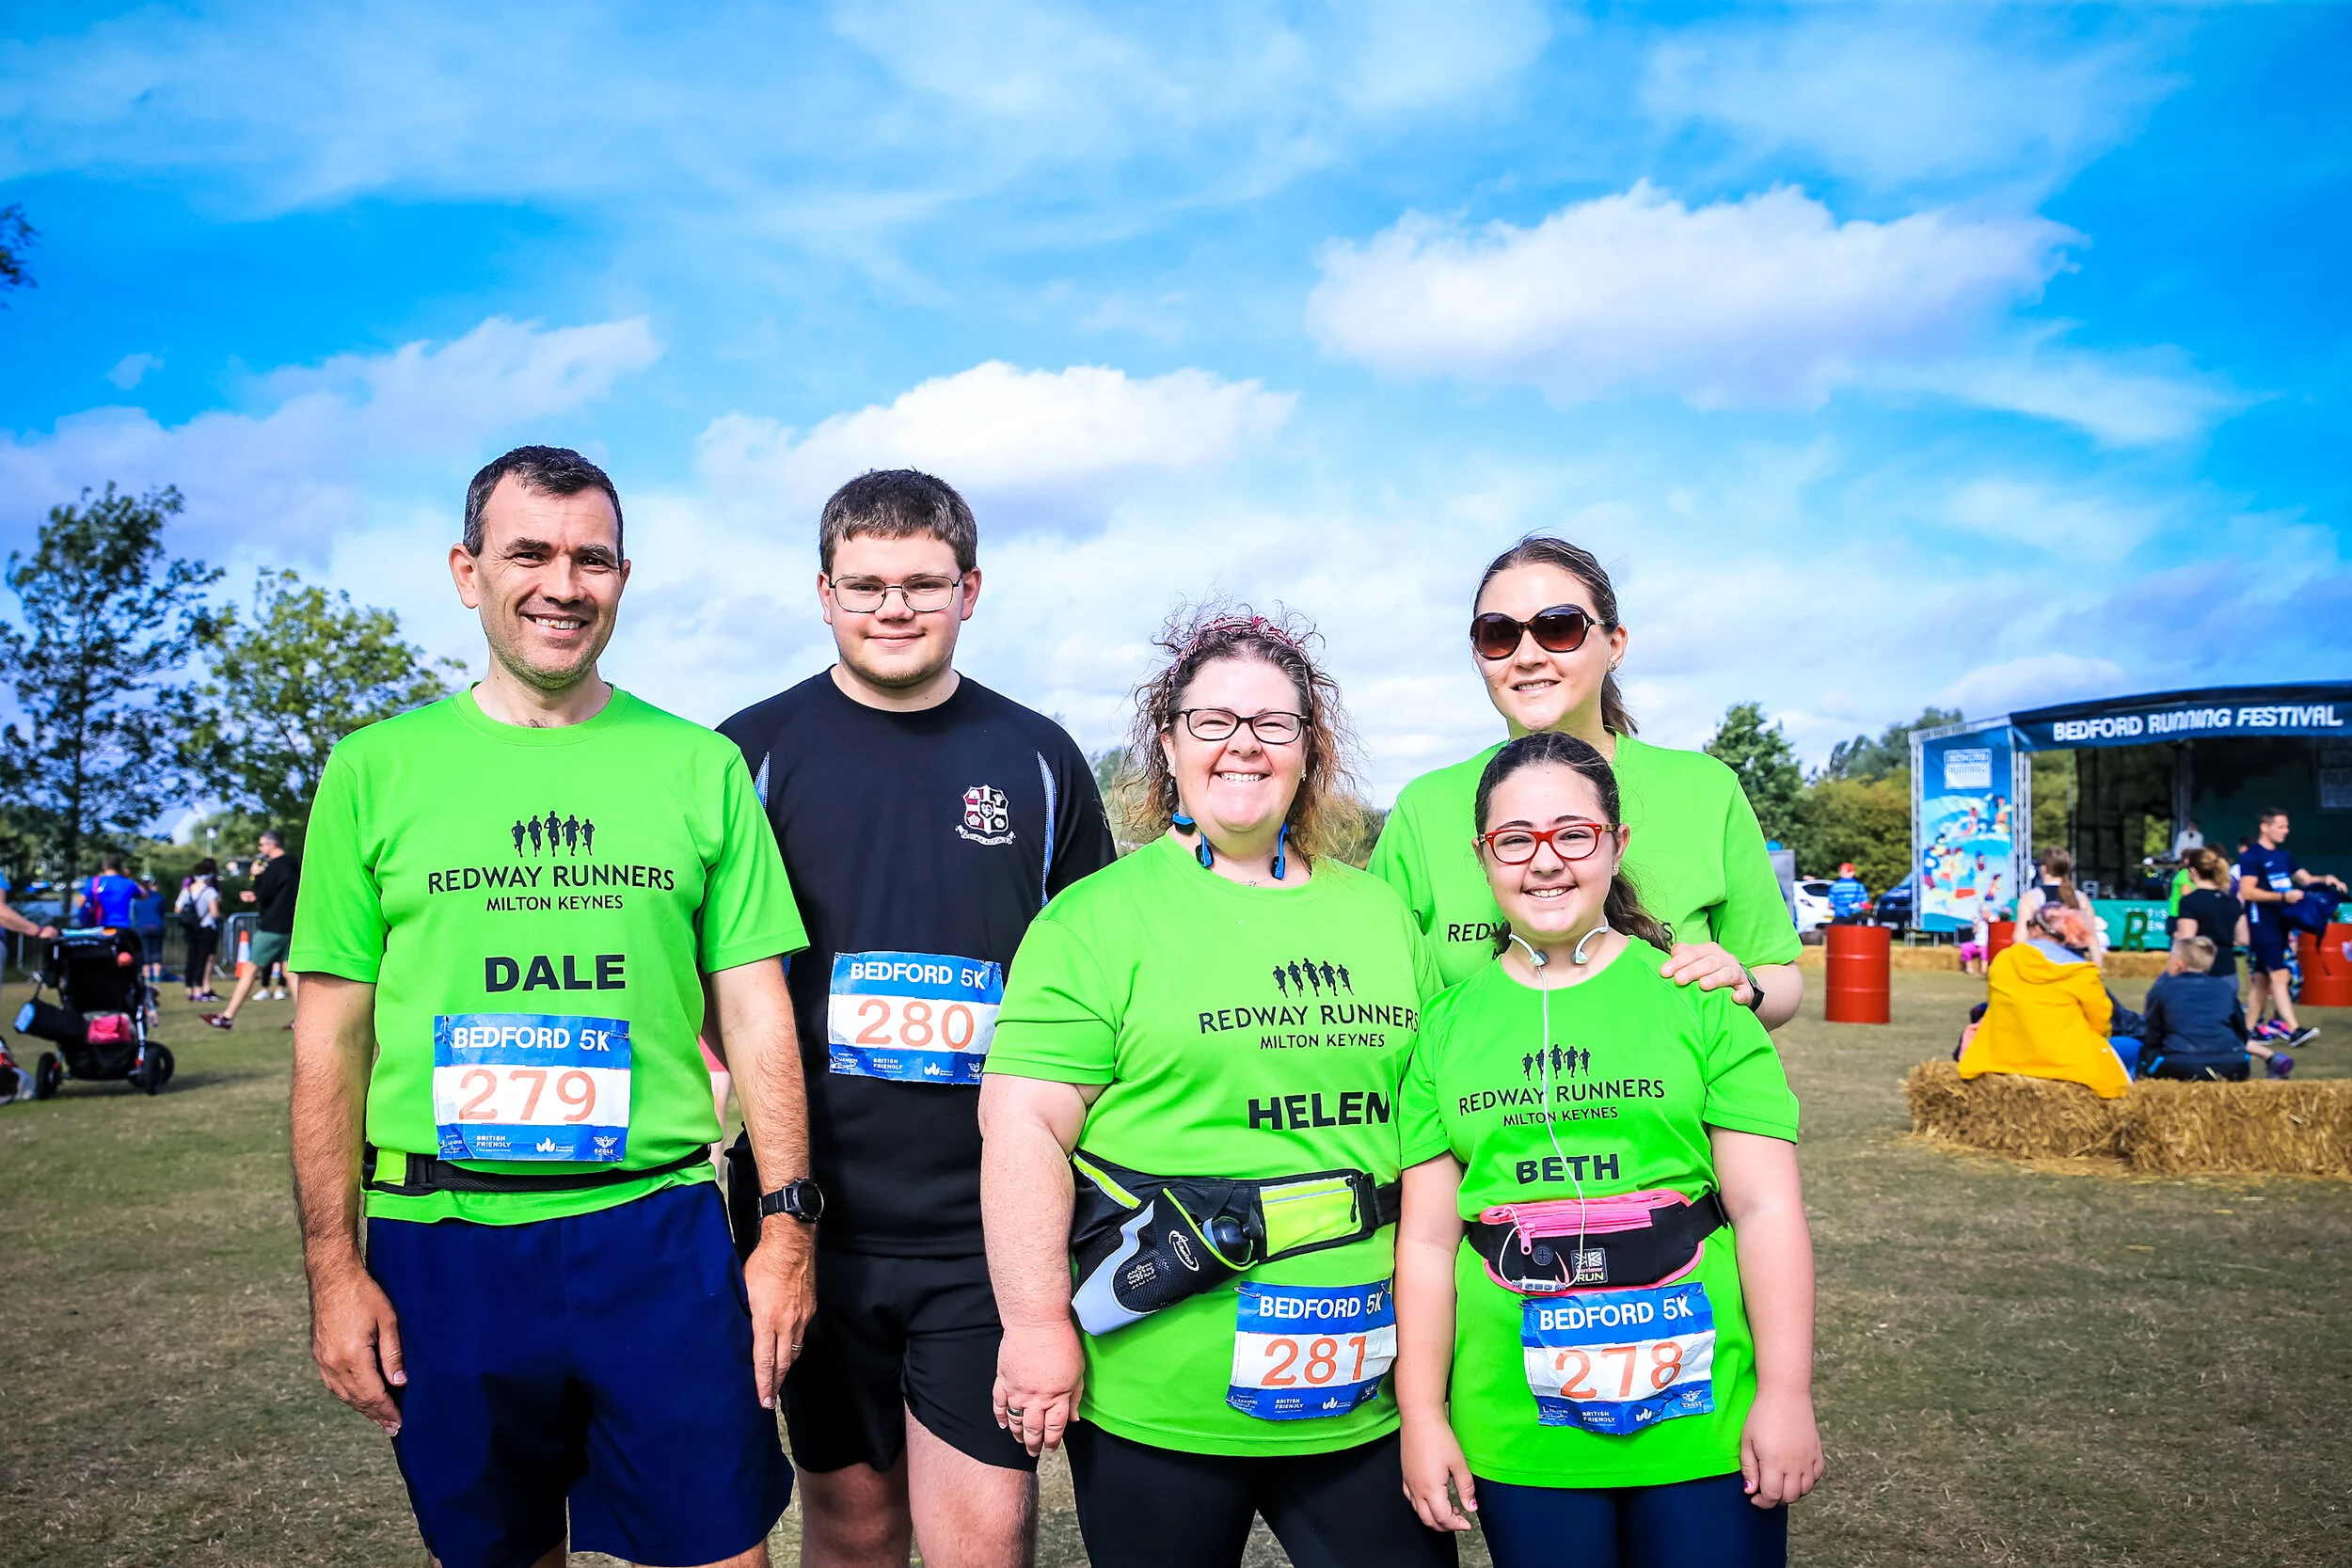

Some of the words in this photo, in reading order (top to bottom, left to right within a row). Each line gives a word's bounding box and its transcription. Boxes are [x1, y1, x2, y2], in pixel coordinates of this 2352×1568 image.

[2053, 716, 2144, 742] BEDFORD
[2236, 705, 2344, 728] FESTIVAL
[428, 865, 543, 895] REDWAY
[552, 864, 675, 892] RUNNERS
[485, 896, 551, 911] MILTON
[557, 895, 624, 911] KEYNES
[485, 954, 627, 992] DALE
[850, 961, 953, 986] BEDFORD
[960, 970, 986, 990] 5K
[855, 998, 975, 1051] 280
[1199, 1005, 1309, 1035] REDWAY
[1320, 1003, 1419, 1033] RUNNERS
[453, 1026, 571, 1051] BEDFORD
[579, 1030, 611, 1053] 5K
[1260, 1034, 1319, 1050] MILTON
[1326, 1033, 1385, 1048] KEYNES
[458, 1068, 597, 1122] 279
[1248, 1091, 1391, 1131] HELEN
[1458, 1086, 1545, 1116] REDWAY
[1556, 1079, 1665, 1103] RUNNERS
[1503, 1111, 1557, 1127] MILTON
[1562, 1106, 1618, 1122] KEYNES
[1516, 1153, 1620, 1185] BETH
[1578, 1272, 1604, 1282] RUN
[1259, 1296, 1361, 1319] BEDFORD
[1365, 1293, 1383, 1315] 5K
[1539, 1302, 1654, 1331] BEDFORD
[1661, 1296, 1694, 1321] 5K
[1260, 1335, 1367, 1386] 281
[1554, 1341, 1684, 1400] 278
